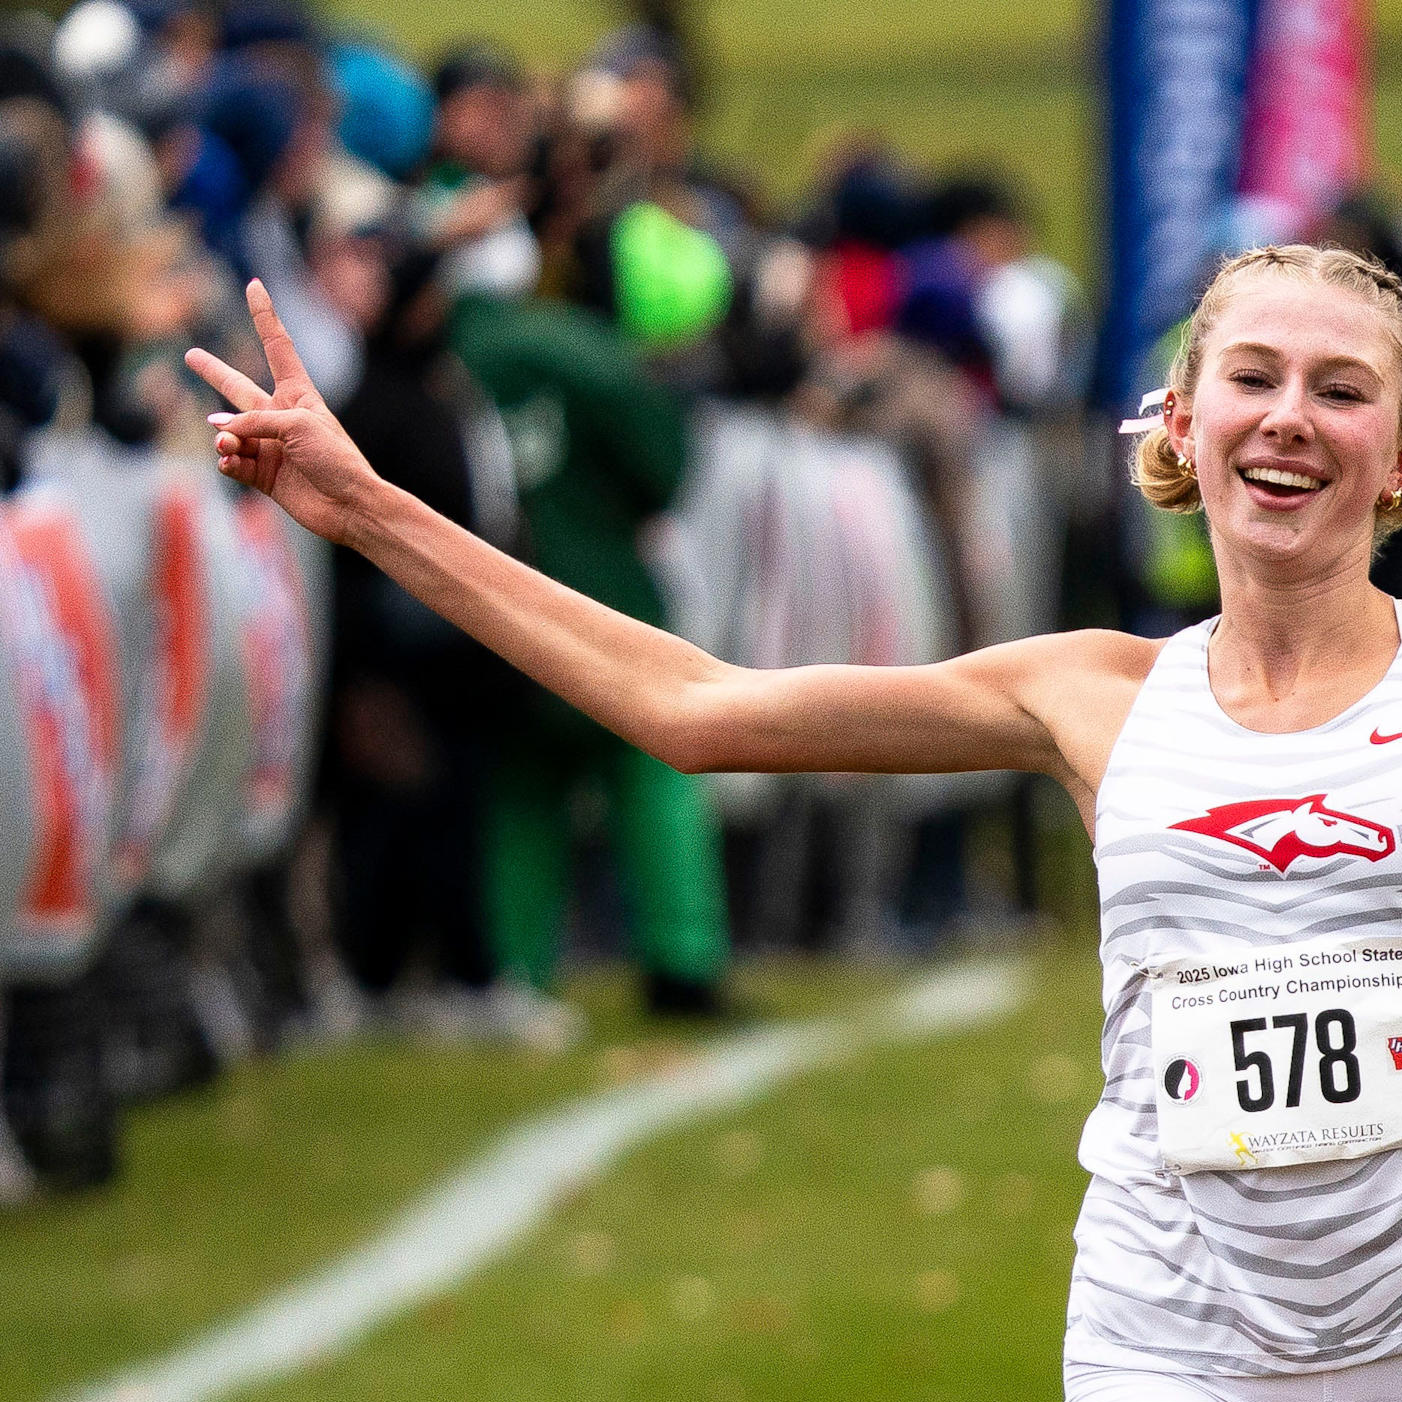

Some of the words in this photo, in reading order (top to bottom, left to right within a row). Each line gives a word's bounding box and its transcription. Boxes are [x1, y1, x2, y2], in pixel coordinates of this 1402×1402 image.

[1177, 967, 1211, 984] 2025
[1213, 963, 1249, 978] Iowa
[1255, 956, 1294, 973] High
[1299, 949, 1357, 967] School
[1172, 994, 1214, 1010] Cross
[1218, 983, 1280, 1003] Country
[1230, 1008, 1362, 1113] 578
[1248, 1130, 1317, 1149] WAYZATA
[1322, 1123, 1384, 1140] RESULTS
